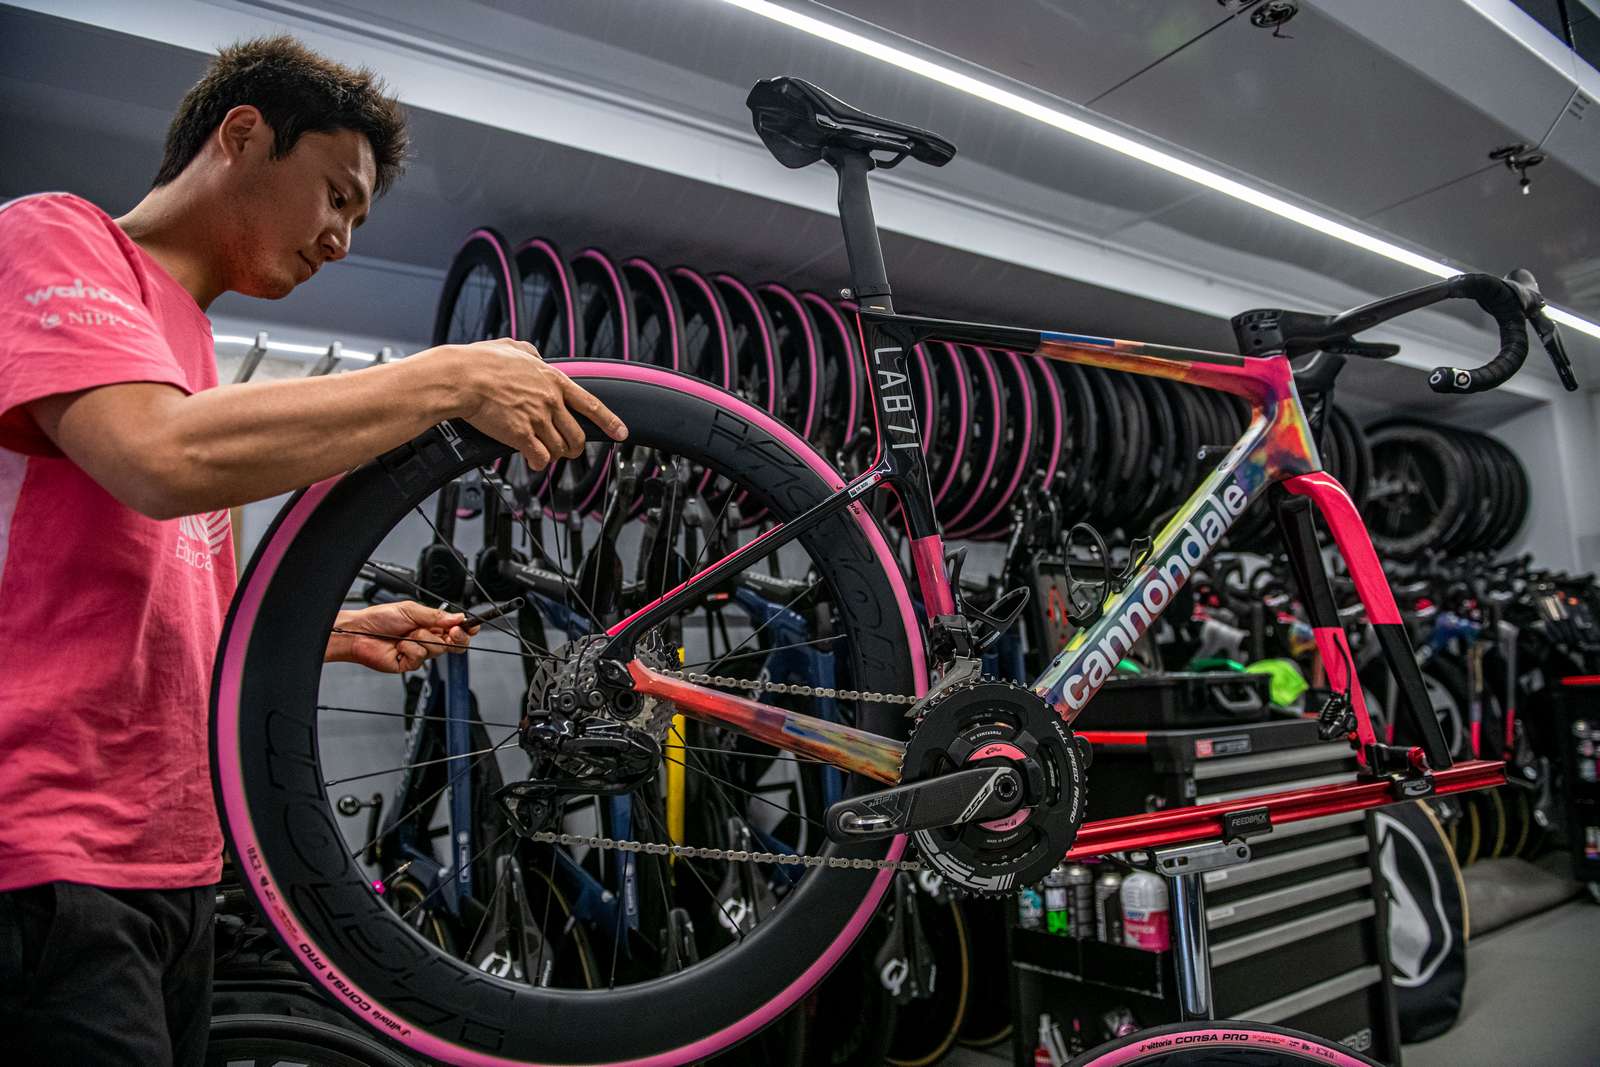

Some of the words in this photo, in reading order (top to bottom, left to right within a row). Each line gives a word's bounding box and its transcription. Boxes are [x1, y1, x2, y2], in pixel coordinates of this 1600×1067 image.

[874, 346, 920, 449] LAB71
[1062, 483, 1248, 710] cannondale
[1051, 720, 1068, 744] FULL
[1066, 747, 1080, 783] SPEED
[1069, 785, 1081, 824] AHEAD
[1231, 813, 1268, 827] FEEDBACK
[298, 943, 327, 972] PRO
[326, 971, 374, 1013] CORSA
[1144, 1038, 1173, 1051] vittoria
[1175, 1034, 1219, 1045] CORSA
[1222, 1033, 1249, 1042] PRO
